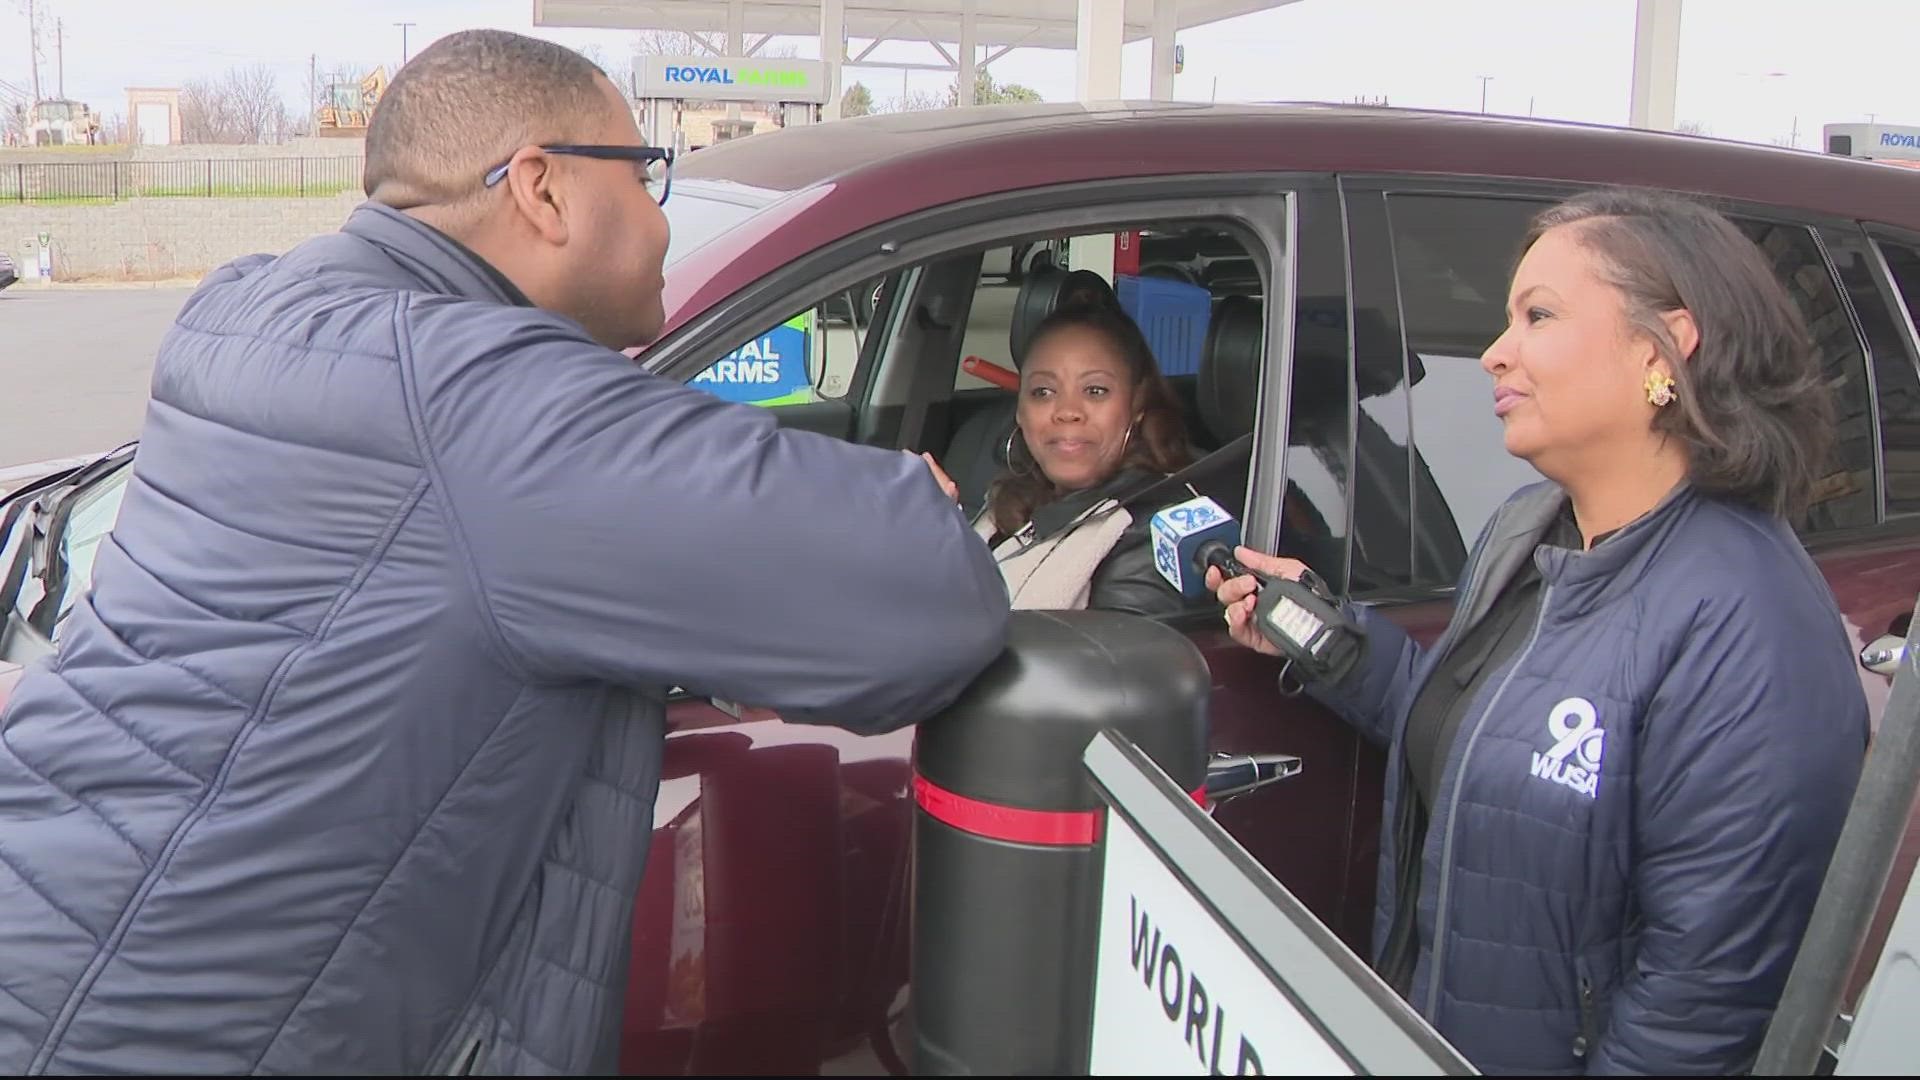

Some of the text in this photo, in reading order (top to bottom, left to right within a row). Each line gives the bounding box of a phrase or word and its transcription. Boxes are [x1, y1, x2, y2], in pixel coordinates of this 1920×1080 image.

[665, 66, 734, 84] ROYAL
[693, 360, 780, 384] ARMS
[1548, 697, 1598, 761] 9
[1530, 751, 1599, 799] WUSA
